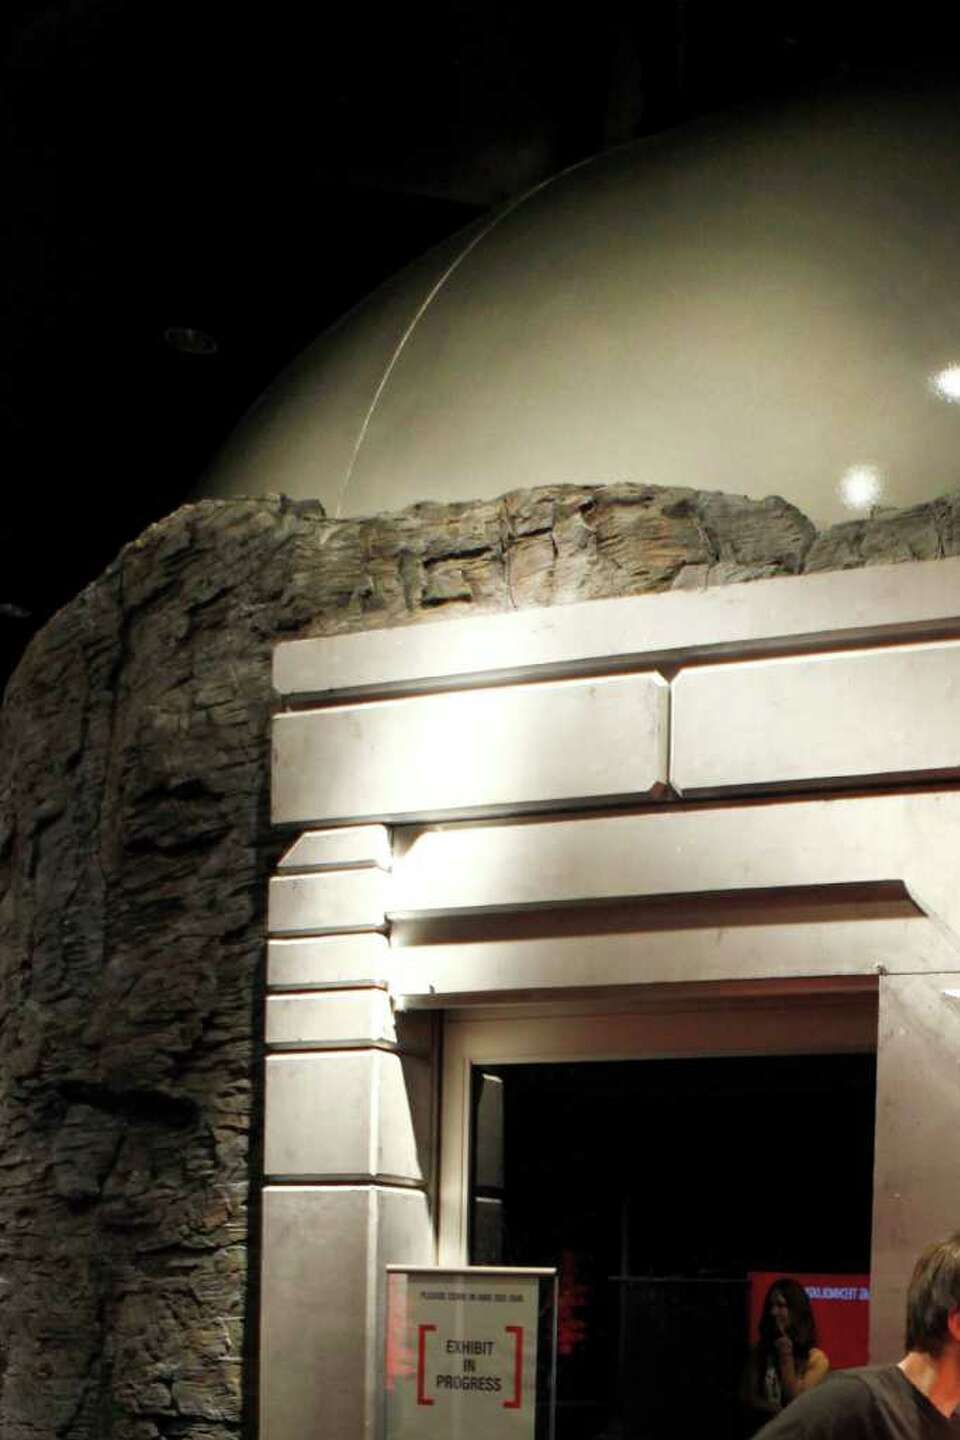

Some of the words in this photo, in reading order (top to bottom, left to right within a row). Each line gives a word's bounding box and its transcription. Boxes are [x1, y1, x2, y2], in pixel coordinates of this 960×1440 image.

[447, 1340, 494, 1356] EXHIBIT
[464, 1359, 476, 1372] IN
[437, 1375, 502, 1392] PROGRESS
